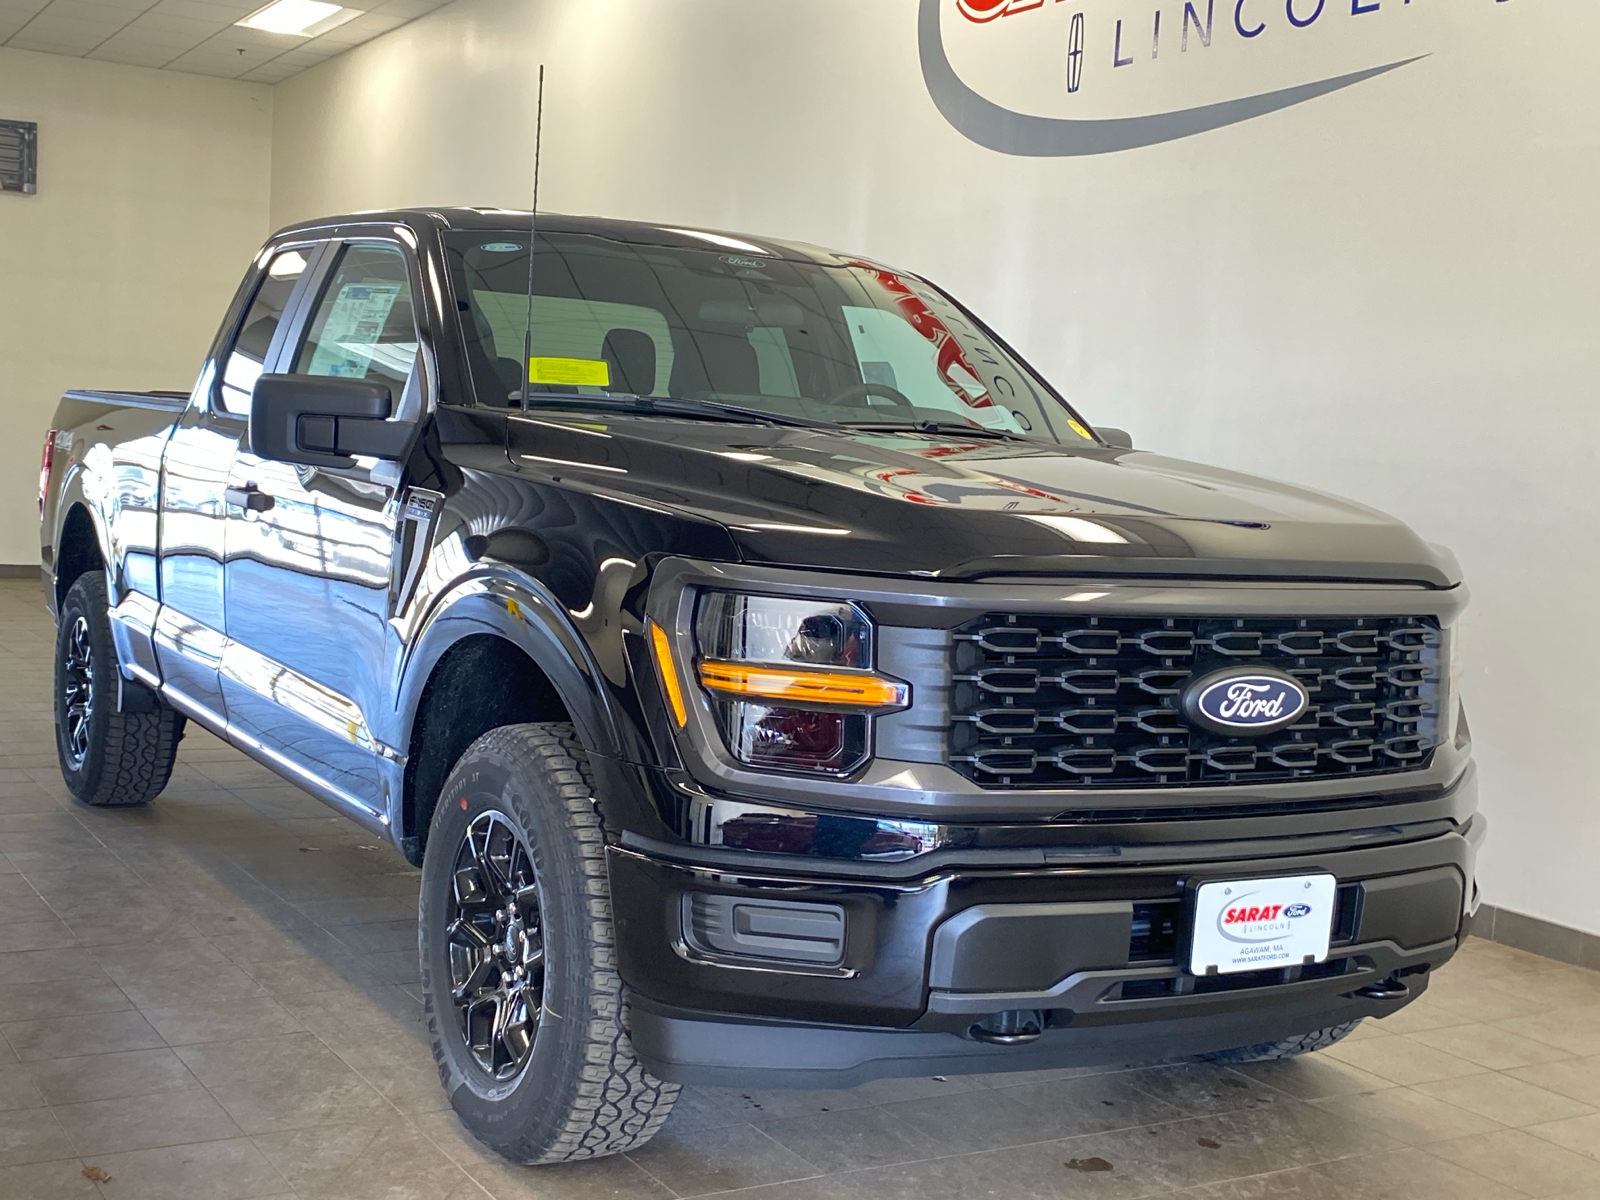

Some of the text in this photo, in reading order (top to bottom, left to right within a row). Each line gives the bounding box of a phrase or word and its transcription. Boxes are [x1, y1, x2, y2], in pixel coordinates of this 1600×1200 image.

[1112, 0, 1410, 68] LINCO
[1219, 682, 1286, 718] Ford
[1224, 904, 1283, 925] SARAT
[1249, 922, 1285, 933] LINCOLN
[1231, 952, 1290, 964] WWW.SARATFORD.COM
[1239, 944, 1284, 956] AGAWAM, MA
